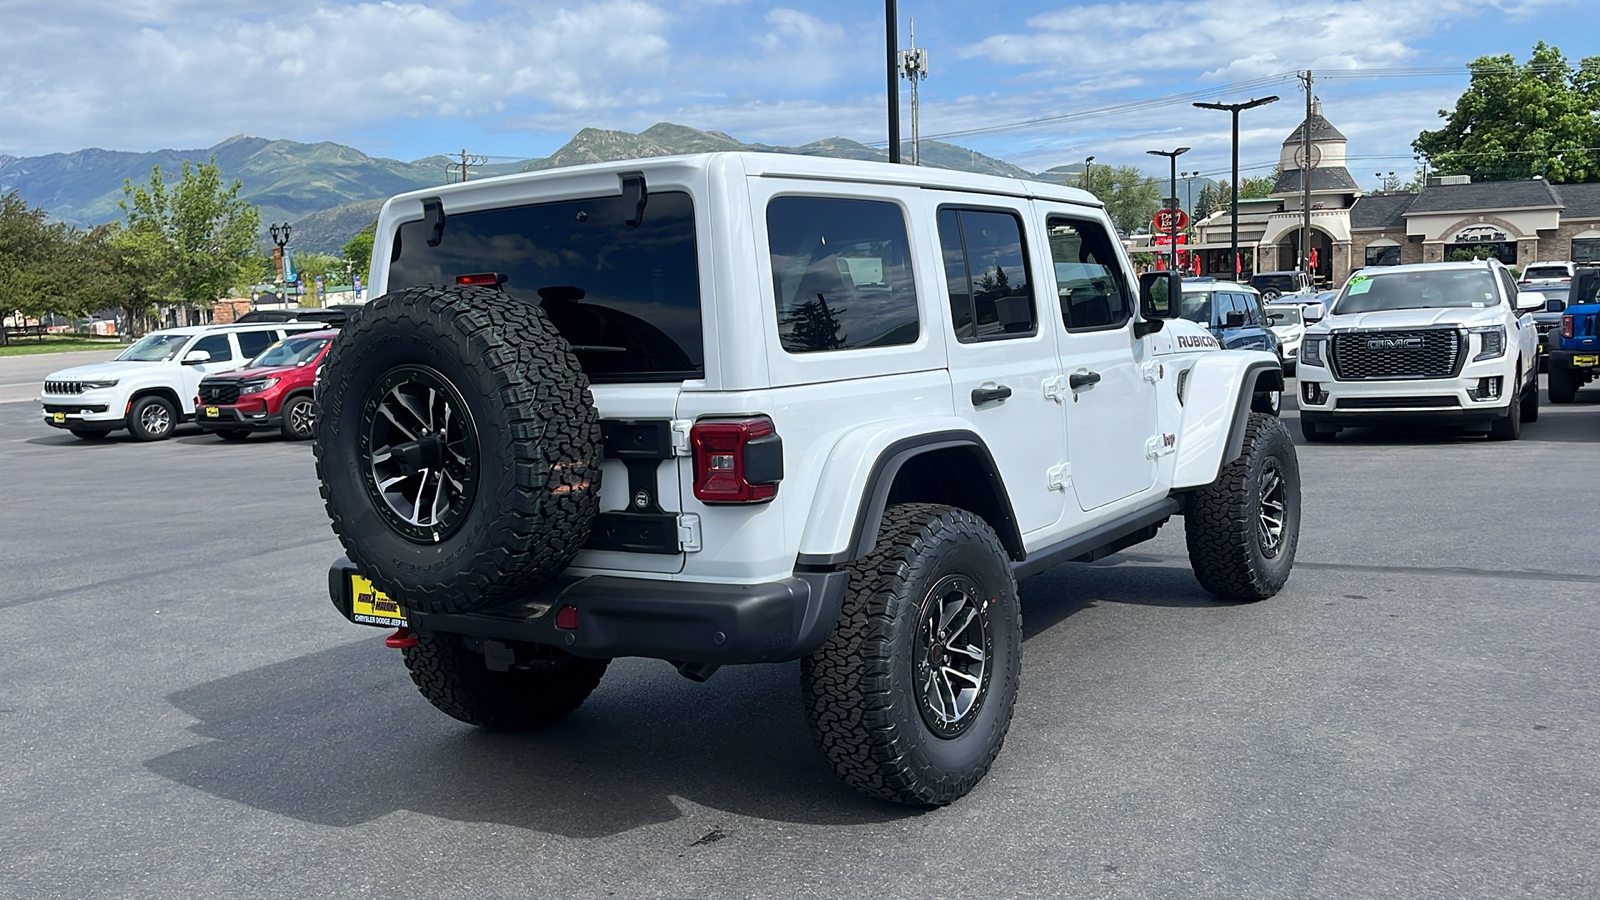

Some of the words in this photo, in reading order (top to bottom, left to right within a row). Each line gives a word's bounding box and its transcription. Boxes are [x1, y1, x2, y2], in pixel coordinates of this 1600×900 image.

[1177, 335, 1219, 348] RUBICON
[1367, 338, 1421, 350] GMC
[355, 615, 375, 623] CHRYSLER
[376, 617, 390, 625] DODGE
